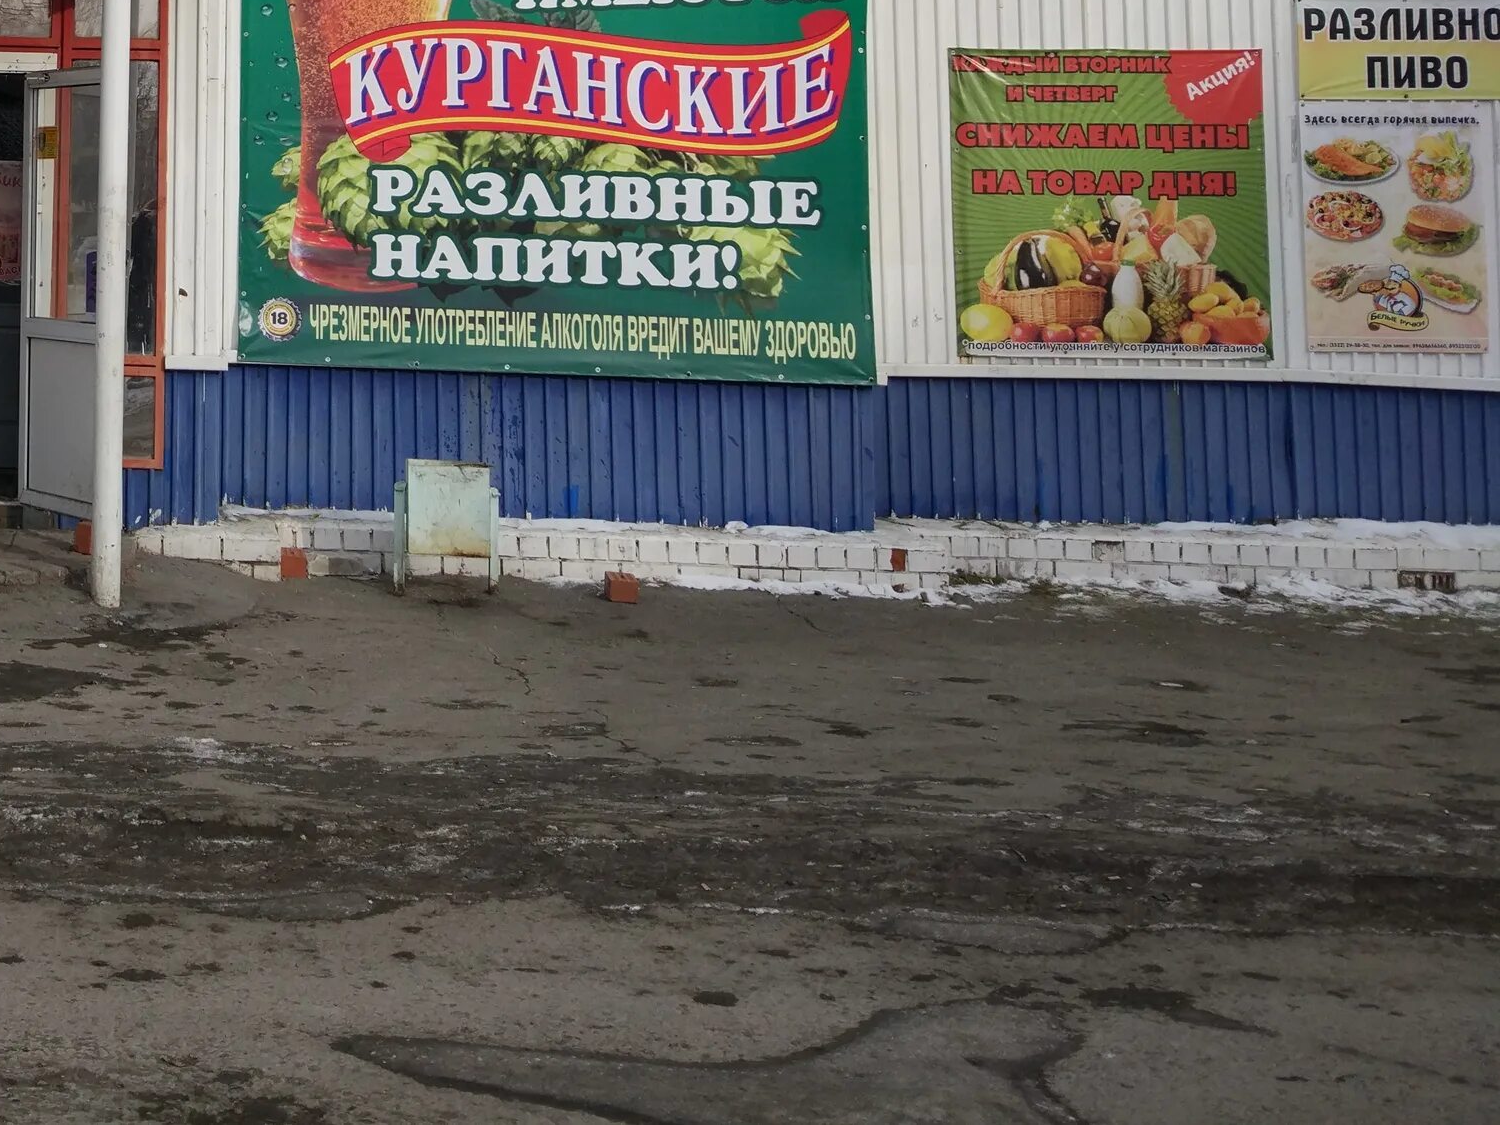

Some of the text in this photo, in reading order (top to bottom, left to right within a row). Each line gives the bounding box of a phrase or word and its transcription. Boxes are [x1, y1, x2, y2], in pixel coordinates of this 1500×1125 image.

[1303, 7, 1500, 41] РАЗЛИВНО
[951, 53, 1172, 74] КАЖДЫЙ ВТОРНИК
[1186, 51, 1256, 101] Акция!
[1366, 55, 1469, 89] ПИВО
[345, 38, 835, 135] КУРГАНСКИЕ
[1006, 86, 1118, 102] И ЧЕТВЕРГ
[1304, 114, 1337, 125] Здесь
[1341, 115, 1380, 126] всегда
[1384, 115, 1427, 126] горячая
[956, 124, 1250, 153] СНИЖАЕМ ЦЕНЫ
[372, 170, 820, 225] РАЗЛИВНЫЕ
[972, 170, 1237, 200] НА ТОВАР ДНЯ!
[372, 234, 740, 289] НАПИТКИ!
[271, 312, 288, 324] 18
[309, 304, 411, 342] ЧРЕЗМЕРНОЕ
[416, 309, 537, 348] УПОТРЕБЛЕНИЕ
[541, 314, 623, 351] АЛКОГОЛЯ
[628, 318, 689, 360] ВРЕДИТ
[694, 319, 761, 356] ВАШЕМУ
[765, 321, 856, 364] ЗДОРОВЬЮ
[1049, 341, 1109, 353] уточняйте
[1112, 344, 1120, 353] у
[1123, 345, 1198, 354] сотрудников
